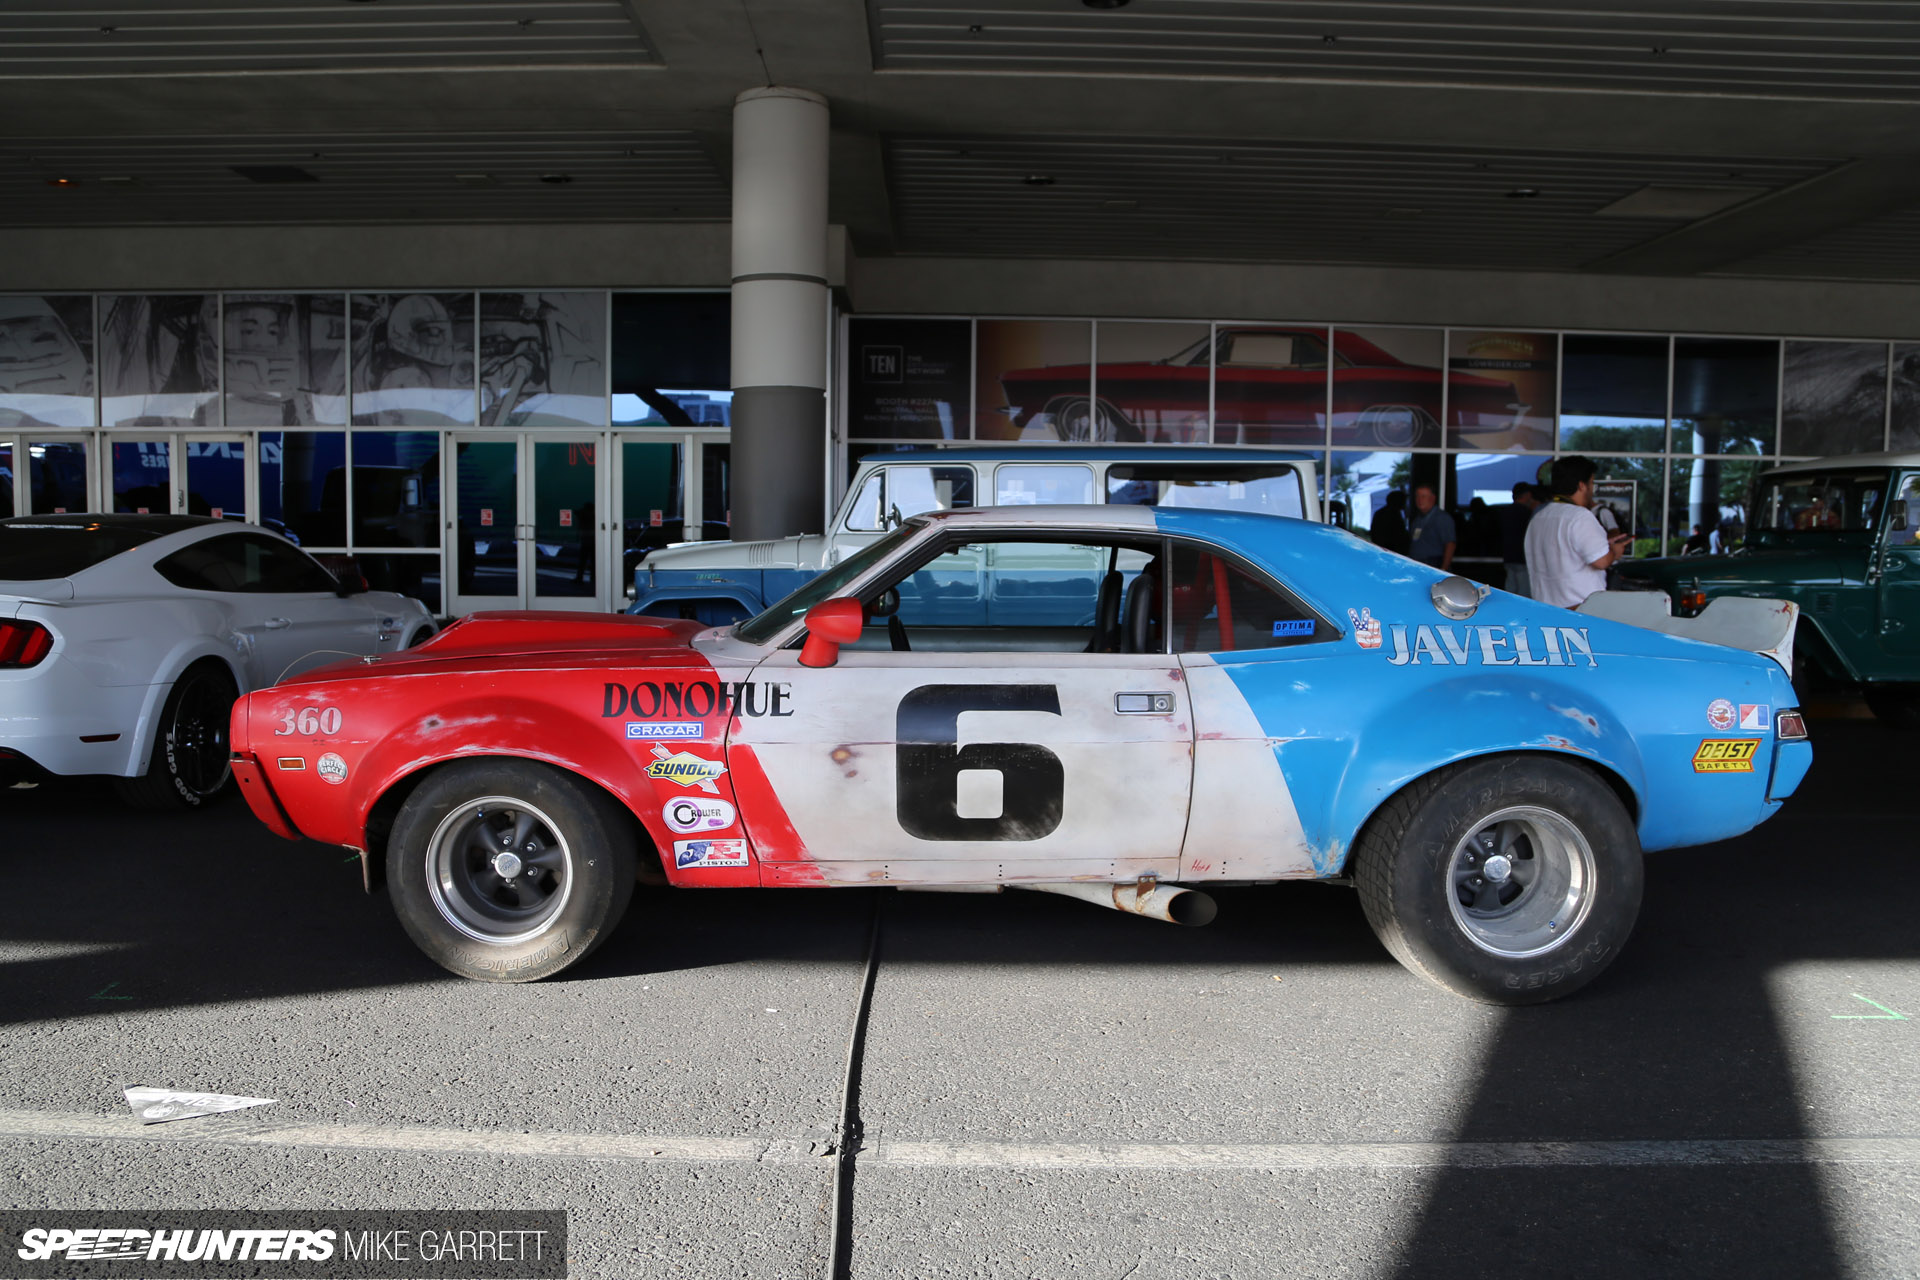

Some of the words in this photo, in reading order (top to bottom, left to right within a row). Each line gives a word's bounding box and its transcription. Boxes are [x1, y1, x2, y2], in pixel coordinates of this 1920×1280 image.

[869, 355, 896, 374] TEN
[1276, 622, 1312, 631] OPTIMA
[1386, 624, 1598, 667] JAVELIN
[602, 682, 794, 718] DONOHUE
[275, 707, 342, 736] 360
[630, 726, 697, 736] CRAGAR
[1698, 743, 1755, 758] DEIST
[319, 758, 345, 770] PERFECT
[321, 766, 343, 775] CIRCLE
[652, 763, 721, 776] SUNOCO
[896, 684, 1064, 841] 6
[1697, 762, 1747, 770] SAFETY
[674, 804, 721, 825] CROWER
[678, 841, 742, 866] JE
[448, 929, 571, 971] AMERICAN
